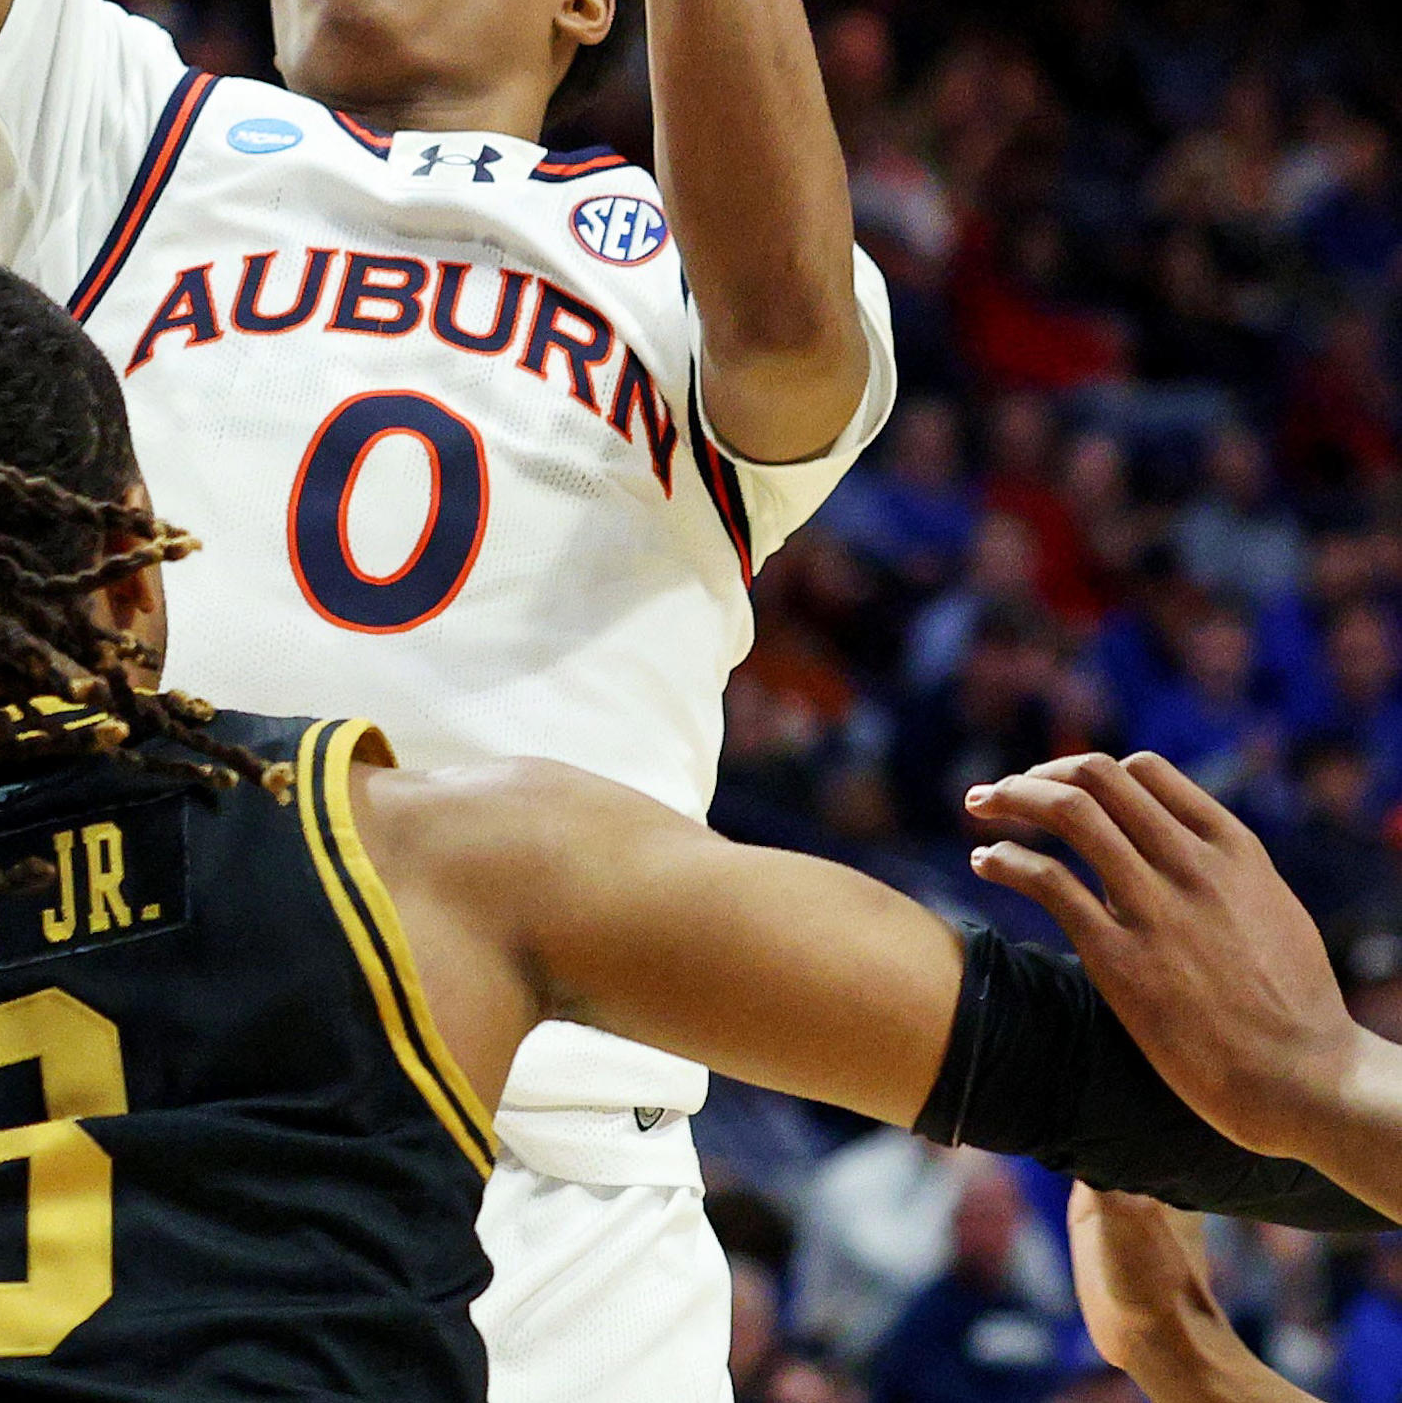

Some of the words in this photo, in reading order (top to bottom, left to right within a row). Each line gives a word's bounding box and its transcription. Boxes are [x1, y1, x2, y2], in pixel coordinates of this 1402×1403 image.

[577, 197, 664, 261] SEC
[125, 247, 679, 499] AUBURN
[287, 389, 489, 635] 0
[41, 821, 162, 944] JR.
